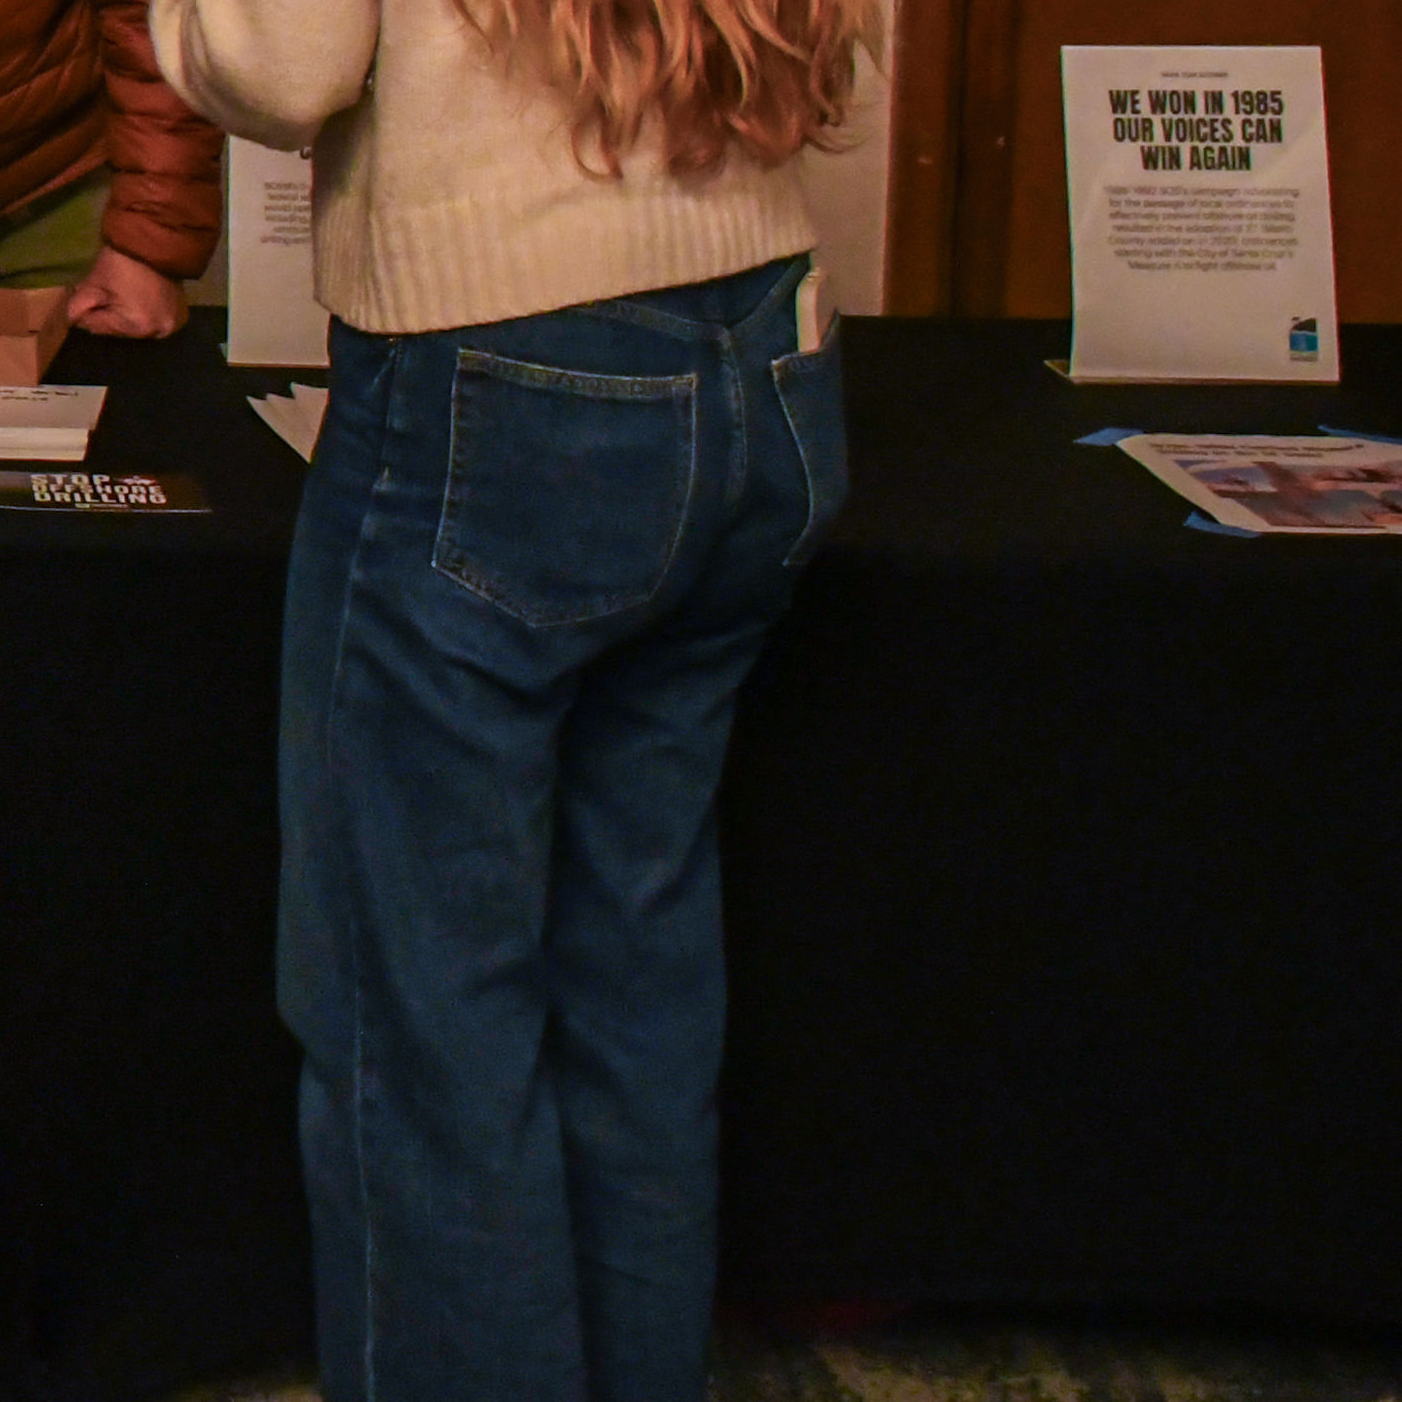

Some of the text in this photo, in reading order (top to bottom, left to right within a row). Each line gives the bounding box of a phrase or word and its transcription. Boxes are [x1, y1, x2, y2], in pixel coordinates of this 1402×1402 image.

[1108, 89, 1284, 115] WE WON IN 1985
[1113, 117, 1283, 143] OUR VOICES CAN
[1140, 145, 1252, 171] WIN AGAIN
[30, 473, 110, 484] STOP
[32, 483, 162, 494] OFFSHORE
[33, 492, 166, 503] DRILLING
